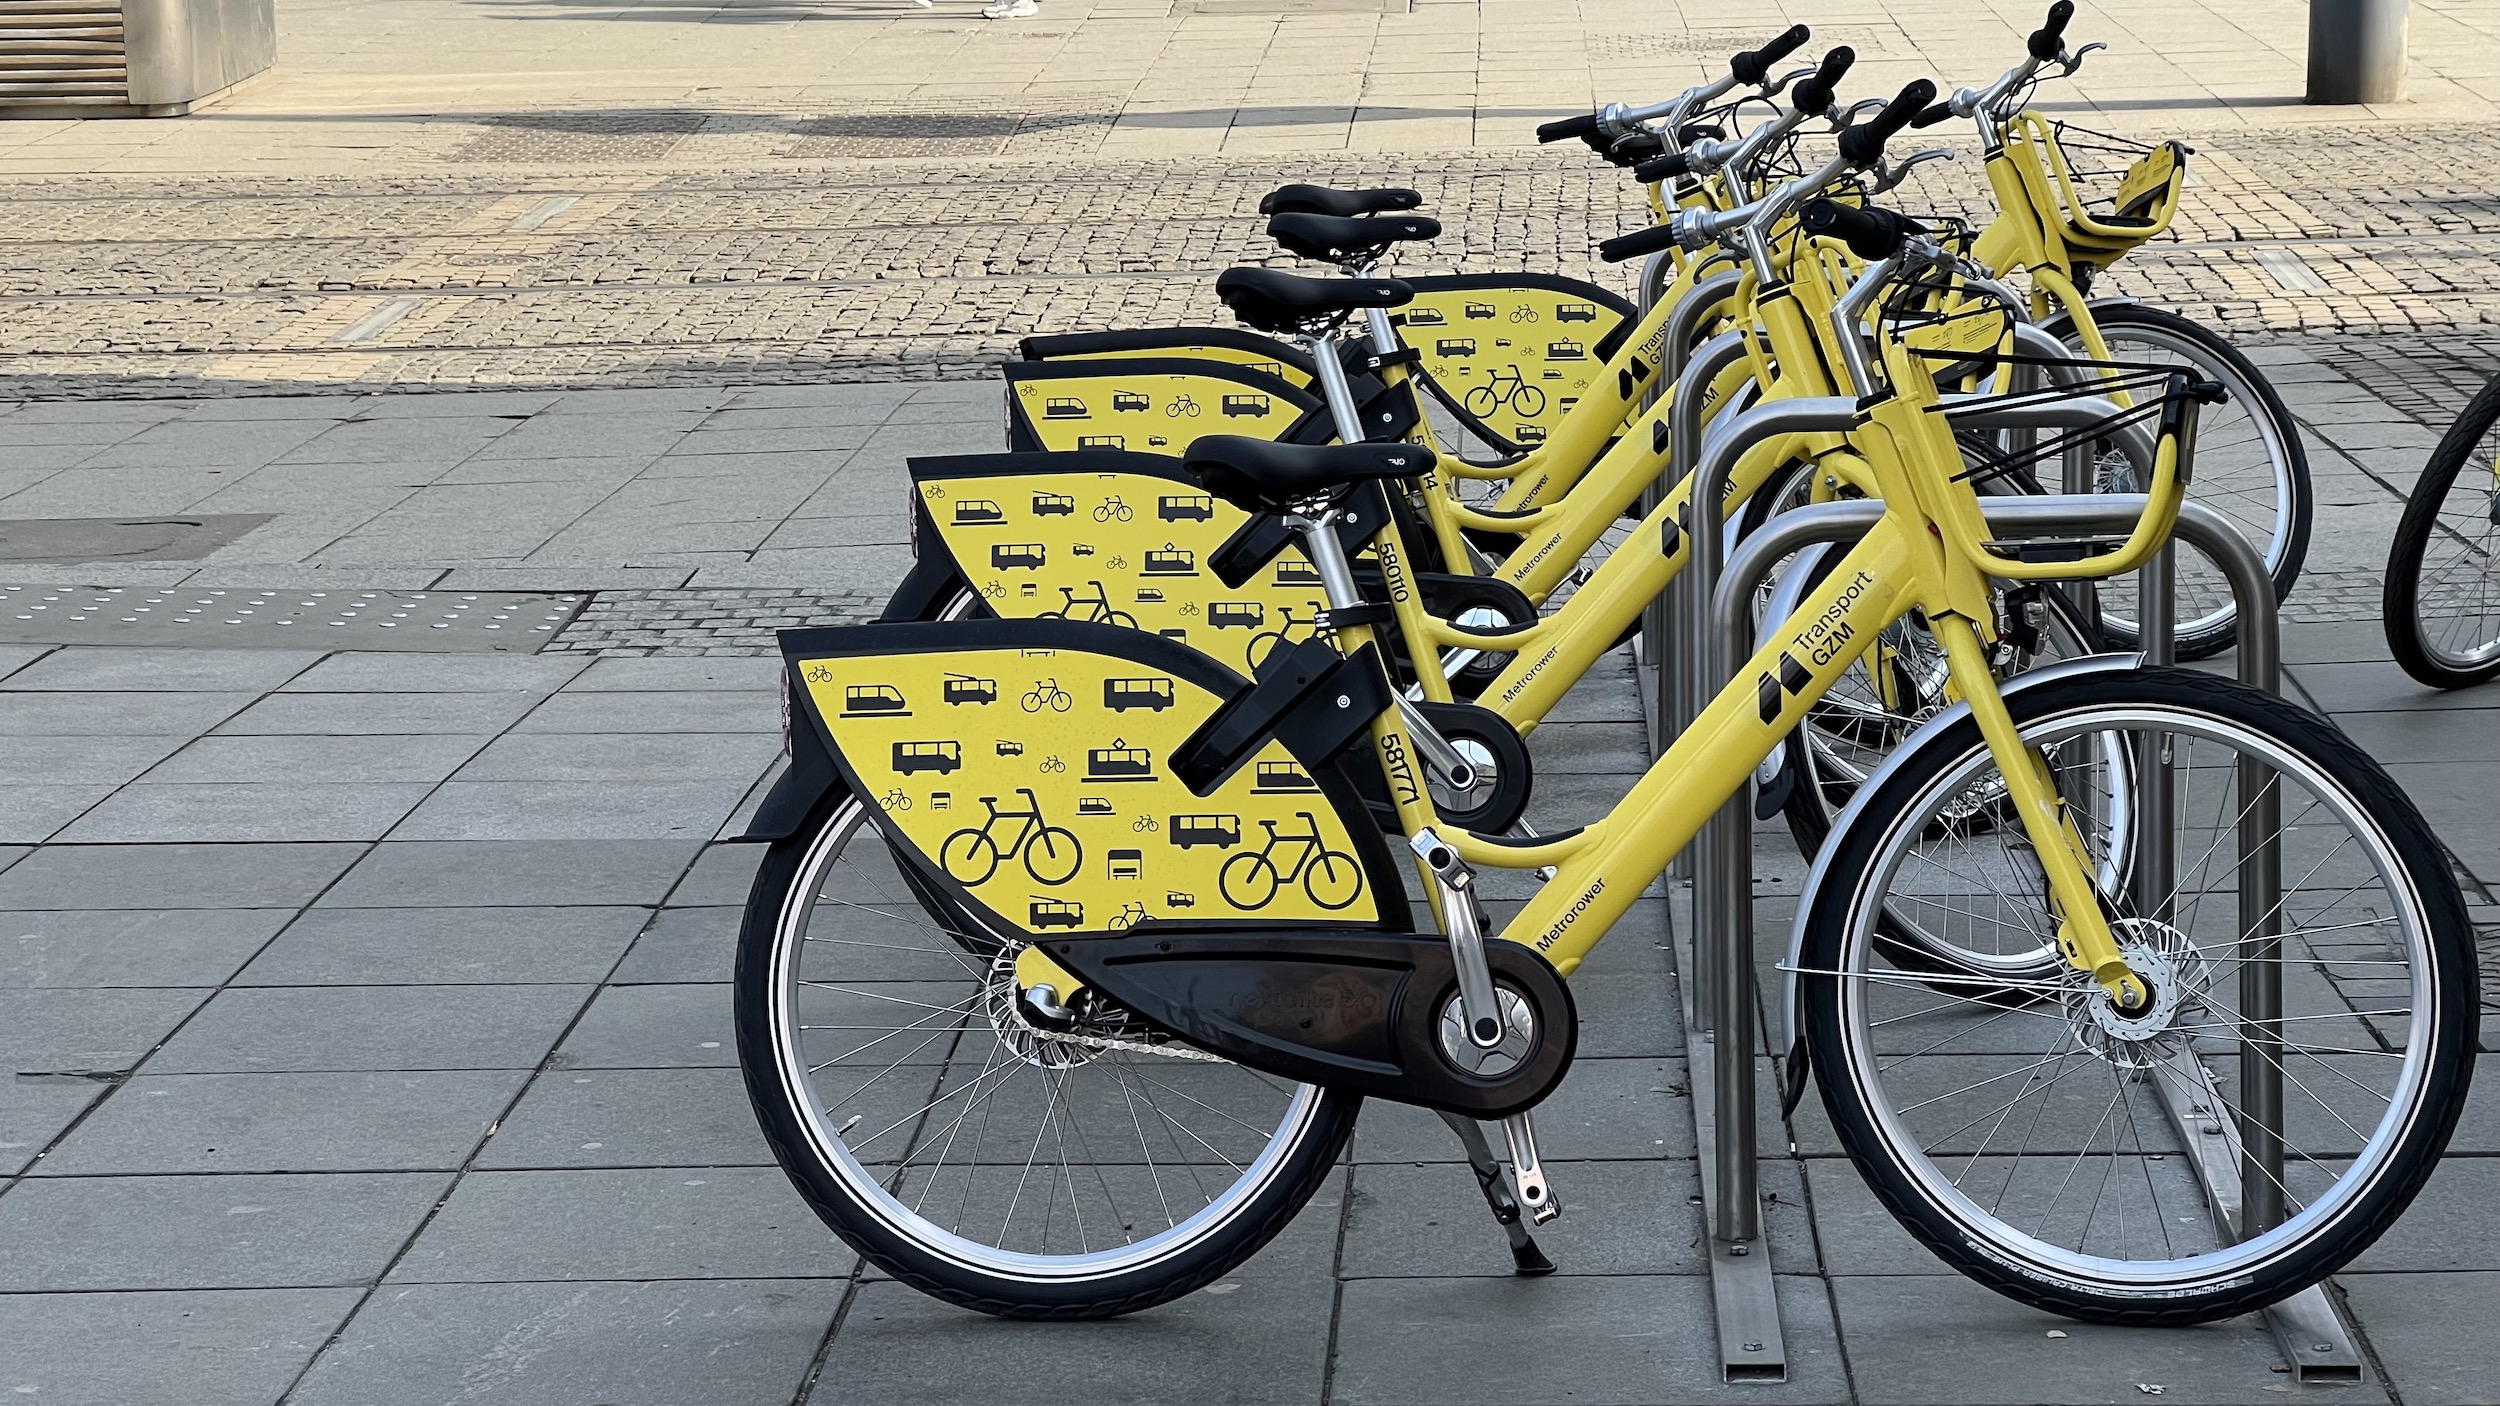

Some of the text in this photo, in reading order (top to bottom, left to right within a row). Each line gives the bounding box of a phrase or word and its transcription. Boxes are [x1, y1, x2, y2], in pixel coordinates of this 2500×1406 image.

[1650, 343, 1665, 365] GZ
[1700, 387, 1719, 413] ZM
[1411, 435, 1438, 491] 514
[1513, 474, 1549, 513] etrorower
[1379, 542, 1409, 603] 580110
[1514, 532, 1562, 582] Metrorower
[1792, 571, 1873, 650] Transport
[1811, 621, 1855, 666] GZM
[1502, 646, 1558, 703] Metrorower
[1380, 733, 1421, 805] 581771
[1536, 877, 1606, 952] Metrorower
